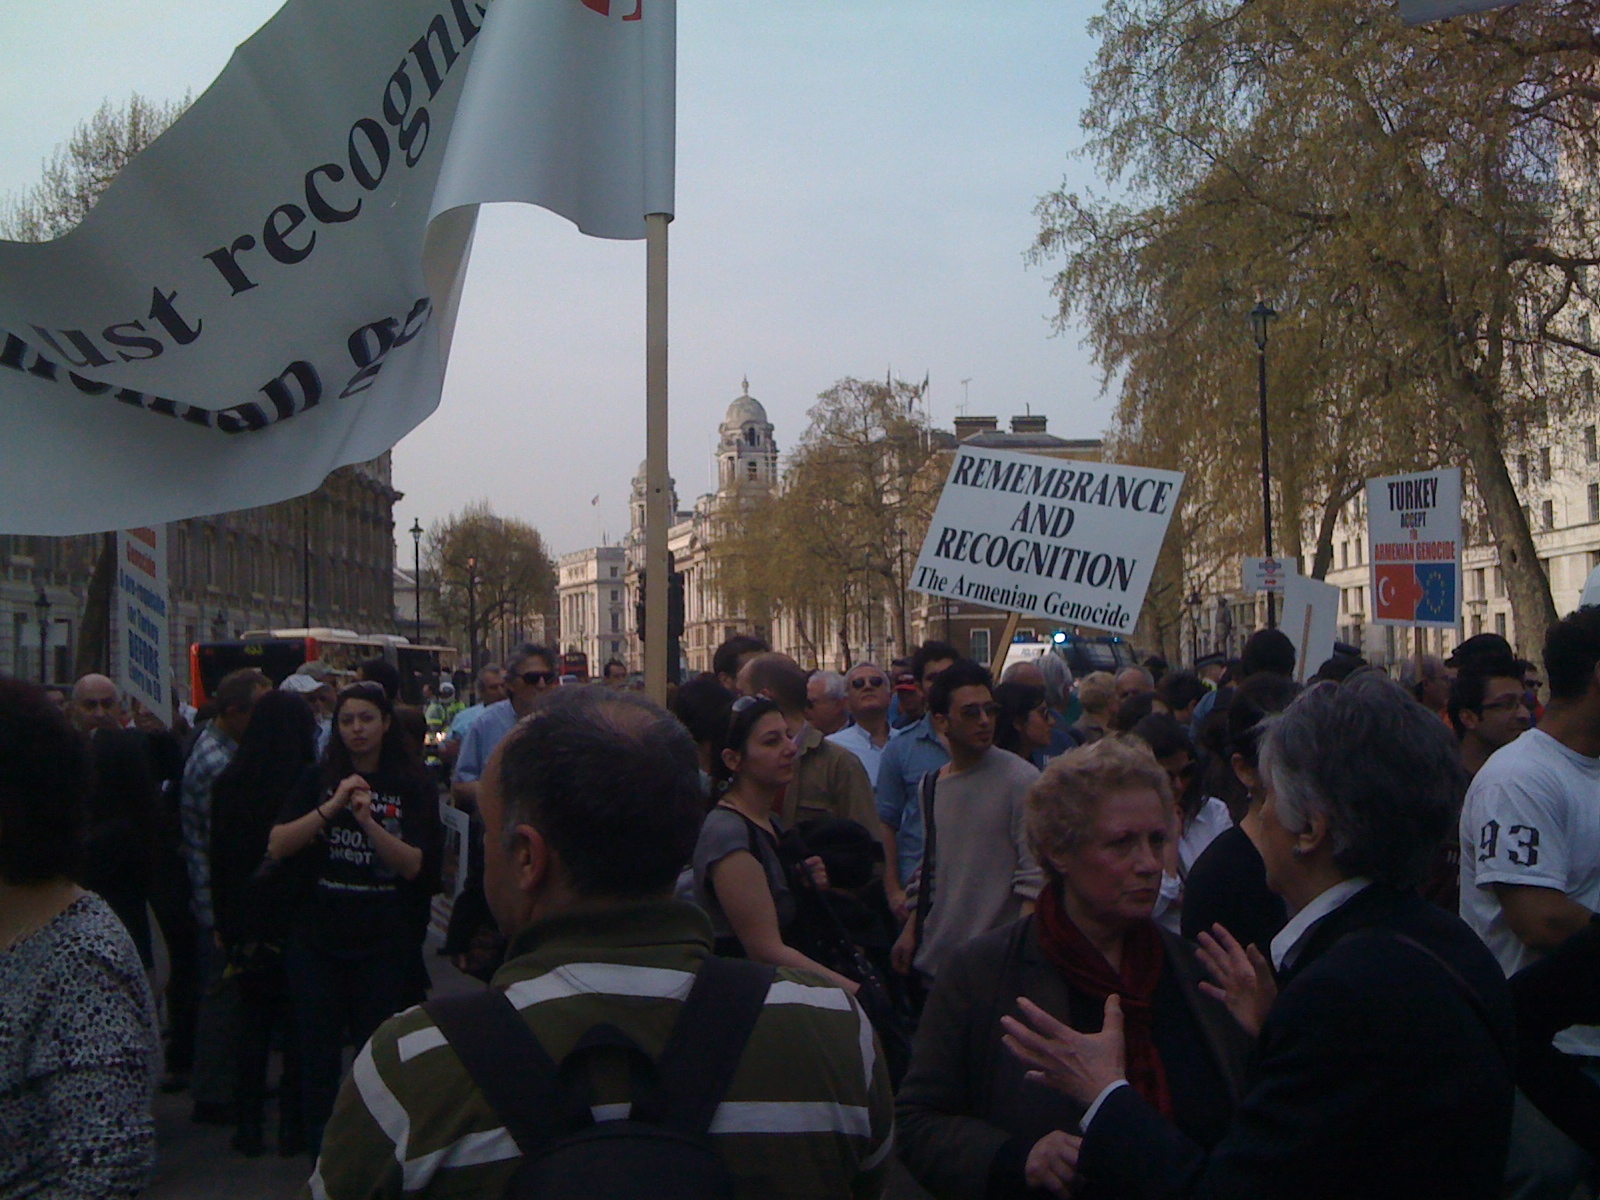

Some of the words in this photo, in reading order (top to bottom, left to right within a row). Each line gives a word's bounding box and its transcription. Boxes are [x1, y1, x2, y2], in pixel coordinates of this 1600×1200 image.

[952, 455, 1173, 515] REMEMBRANCE
[1387, 476, 1438, 511] TURKEY
[1010, 500, 1075, 539] AND
[1400, 511, 1426, 528] ACCEPT
[934, 526, 1137, 593] RECOGNITION
[1416, 541, 1456, 560] GENOCIDE
[916, 566, 948, 592] The
[950, 574, 1038, 612] Armenian
[1044, 592, 1130, 629] Genocide
[1478, 819, 1540, 867] 93
